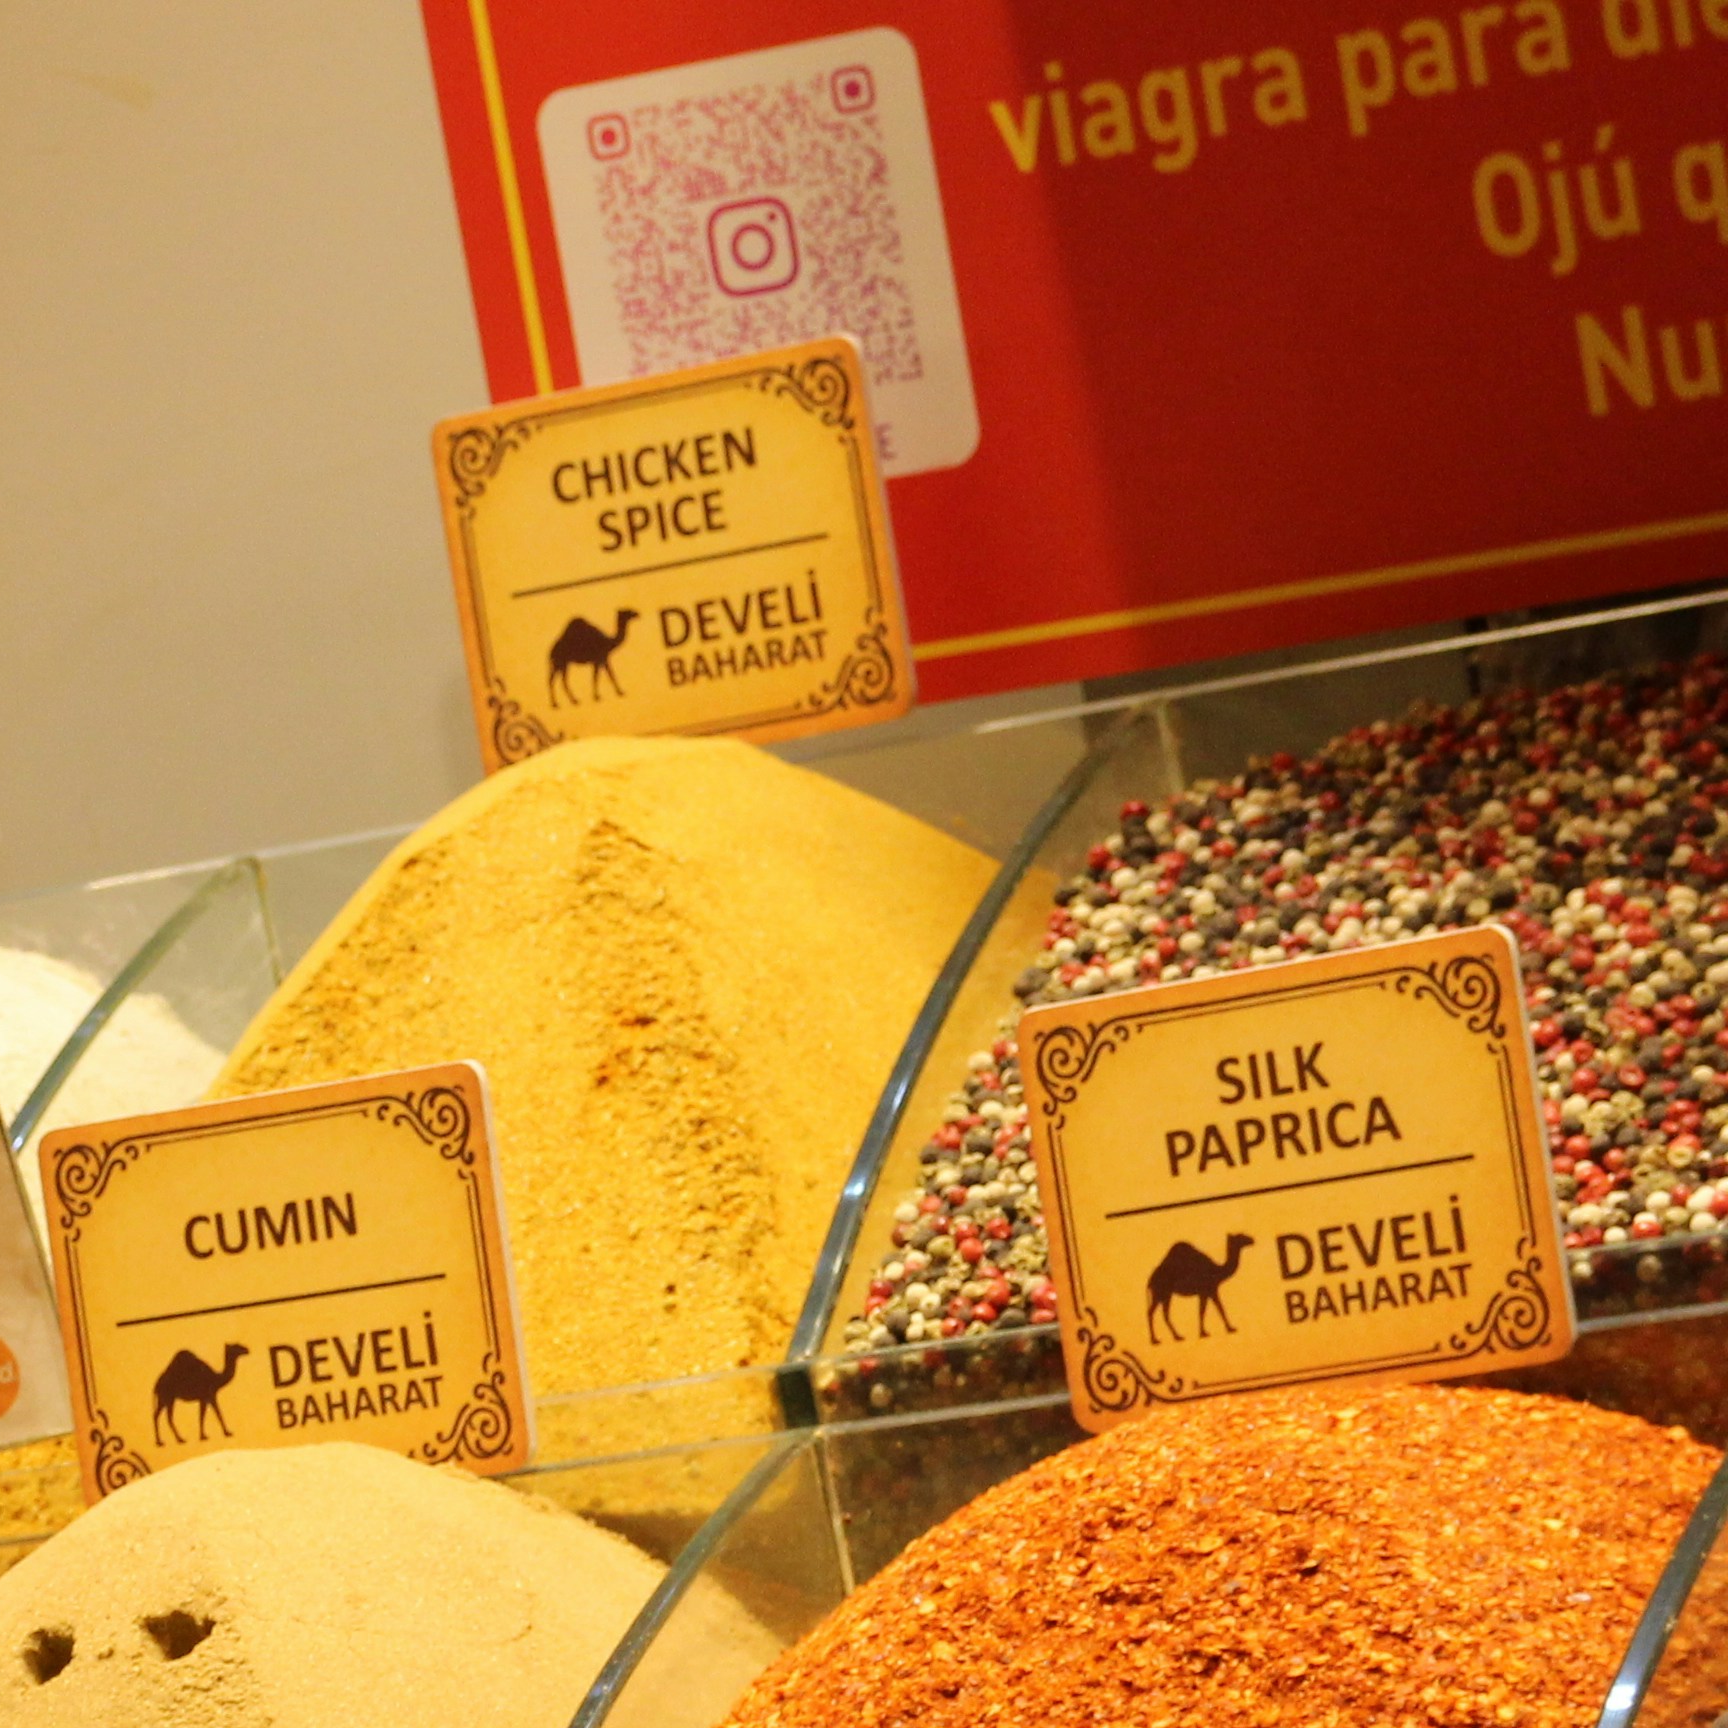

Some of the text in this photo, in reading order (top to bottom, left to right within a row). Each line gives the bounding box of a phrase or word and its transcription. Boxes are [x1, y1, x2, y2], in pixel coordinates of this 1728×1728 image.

[990, 48, 1307, 173] viagra
[1336, 0, 1572, 136] para
[1472, 124, 1641, 277] Ojú
[552, 427, 757, 503] CHICKEN
[598, 490, 727, 552] SPICE
[667, 630, 829, 688] BAHARAT
[1216, 1041, 1330, 1105] SILK
[1165, 1096, 1402, 1177] PAPRICA
[183, 1192, 358, 1260] CUMIN
[1283, 1263, 1473, 1324] BAHARAT
[276, 1375, 444, 1431] BAHARAT
